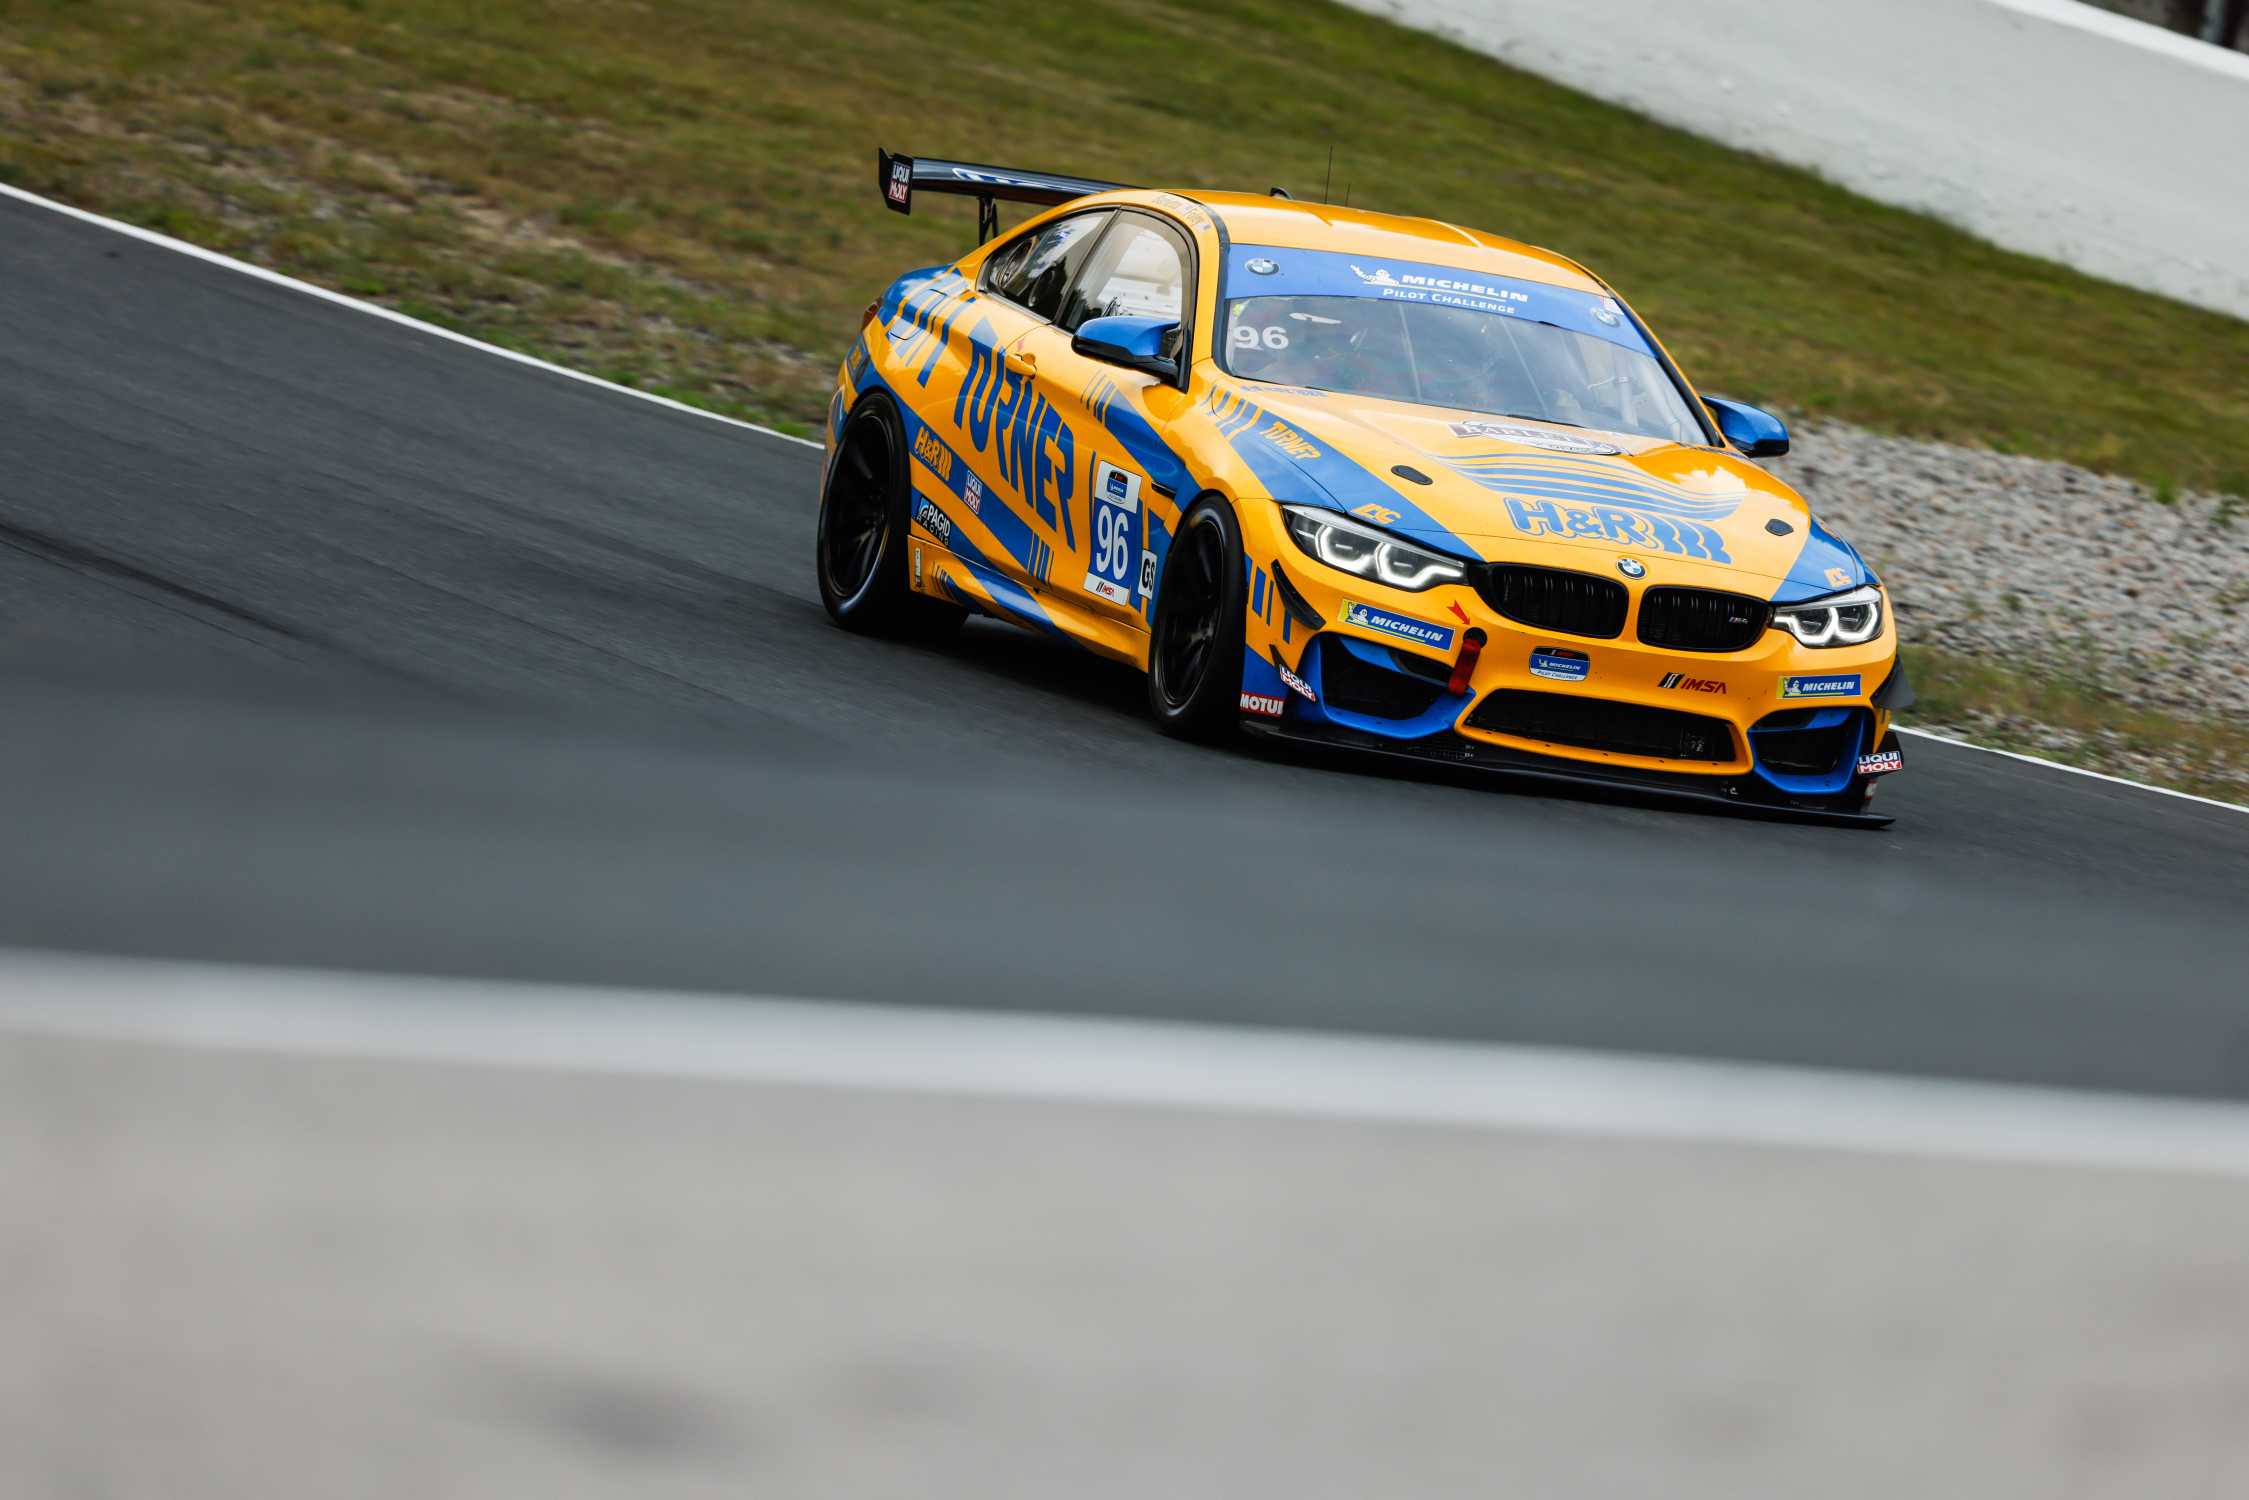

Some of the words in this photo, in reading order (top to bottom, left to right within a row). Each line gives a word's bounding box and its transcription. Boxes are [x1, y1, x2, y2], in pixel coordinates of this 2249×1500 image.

[1383, 288, 1427, 300] PILOT
[1431, 293, 1516, 314] CHALLENGE
[1401, 274, 1529, 303] MICHELIN
[1232, 325, 1289, 350] 96
[954, 316, 1075, 553] TURNER
[1259, 420, 1321, 459] TURNER
[917, 511, 949, 546] RACING
[927, 503, 951, 538] PAGID
[1096, 504, 1129, 580] 96
[1141, 557, 1156, 592] GS
[1370, 615, 1443, 642] MICHELIN
[1680, 676, 1727, 695] IMSA
[1802, 680, 1855, 692] MICHELIN
[1858, 751, 1898, 764] LIQUI
[1859, 760, 1901, 773] MOLY
